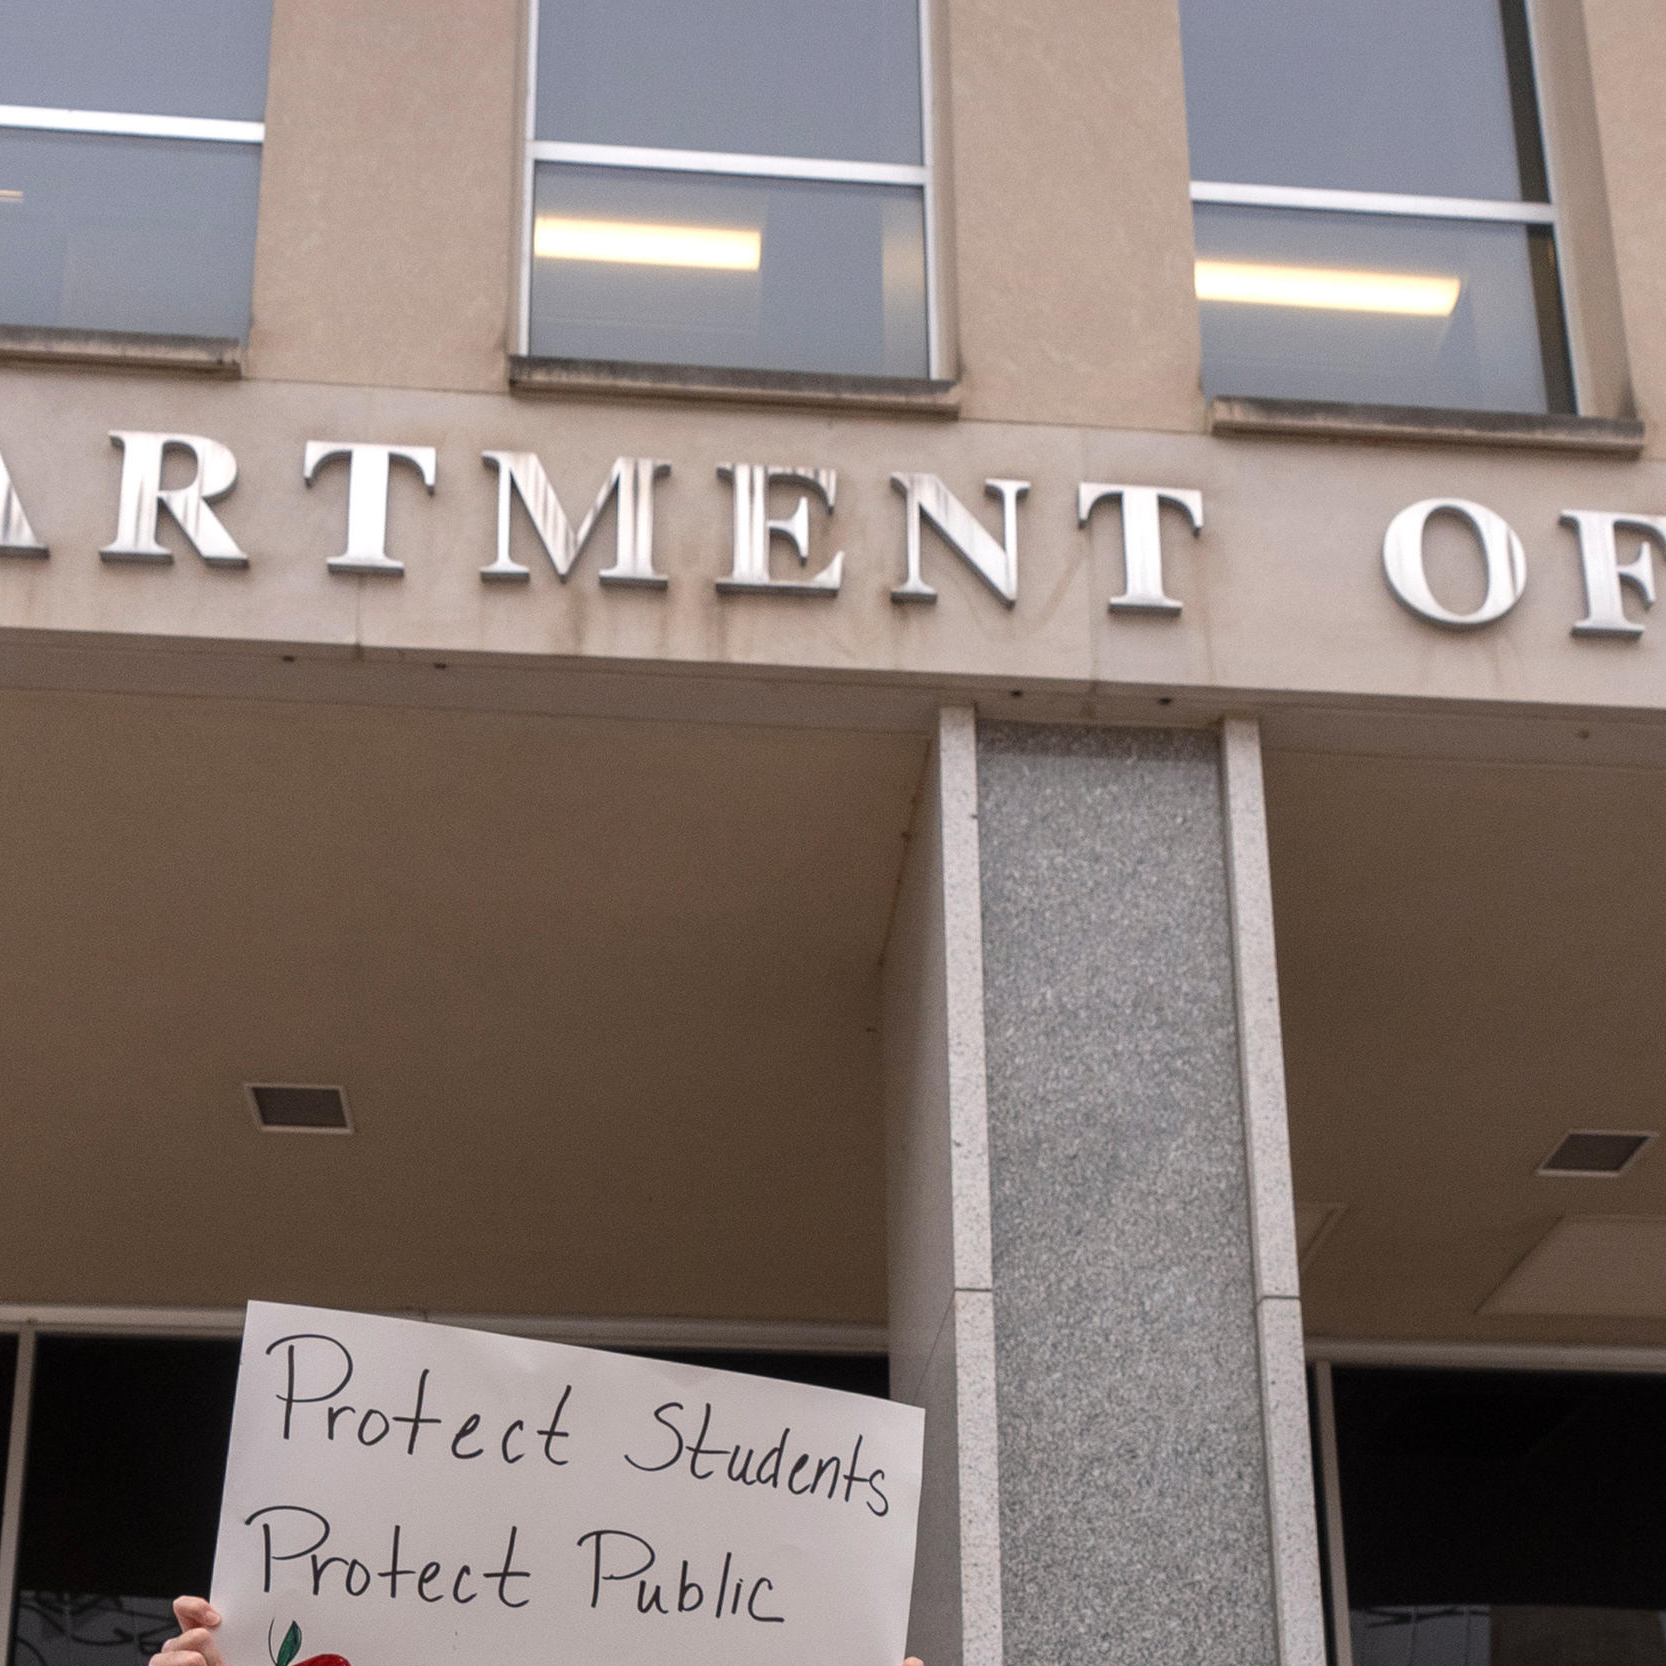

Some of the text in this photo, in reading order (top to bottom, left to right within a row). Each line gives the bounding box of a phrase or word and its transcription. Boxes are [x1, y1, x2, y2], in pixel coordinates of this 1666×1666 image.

[266, 1333, 890, 1518] Protect Students
[244, 1506, 785, 1623] Protect Public
